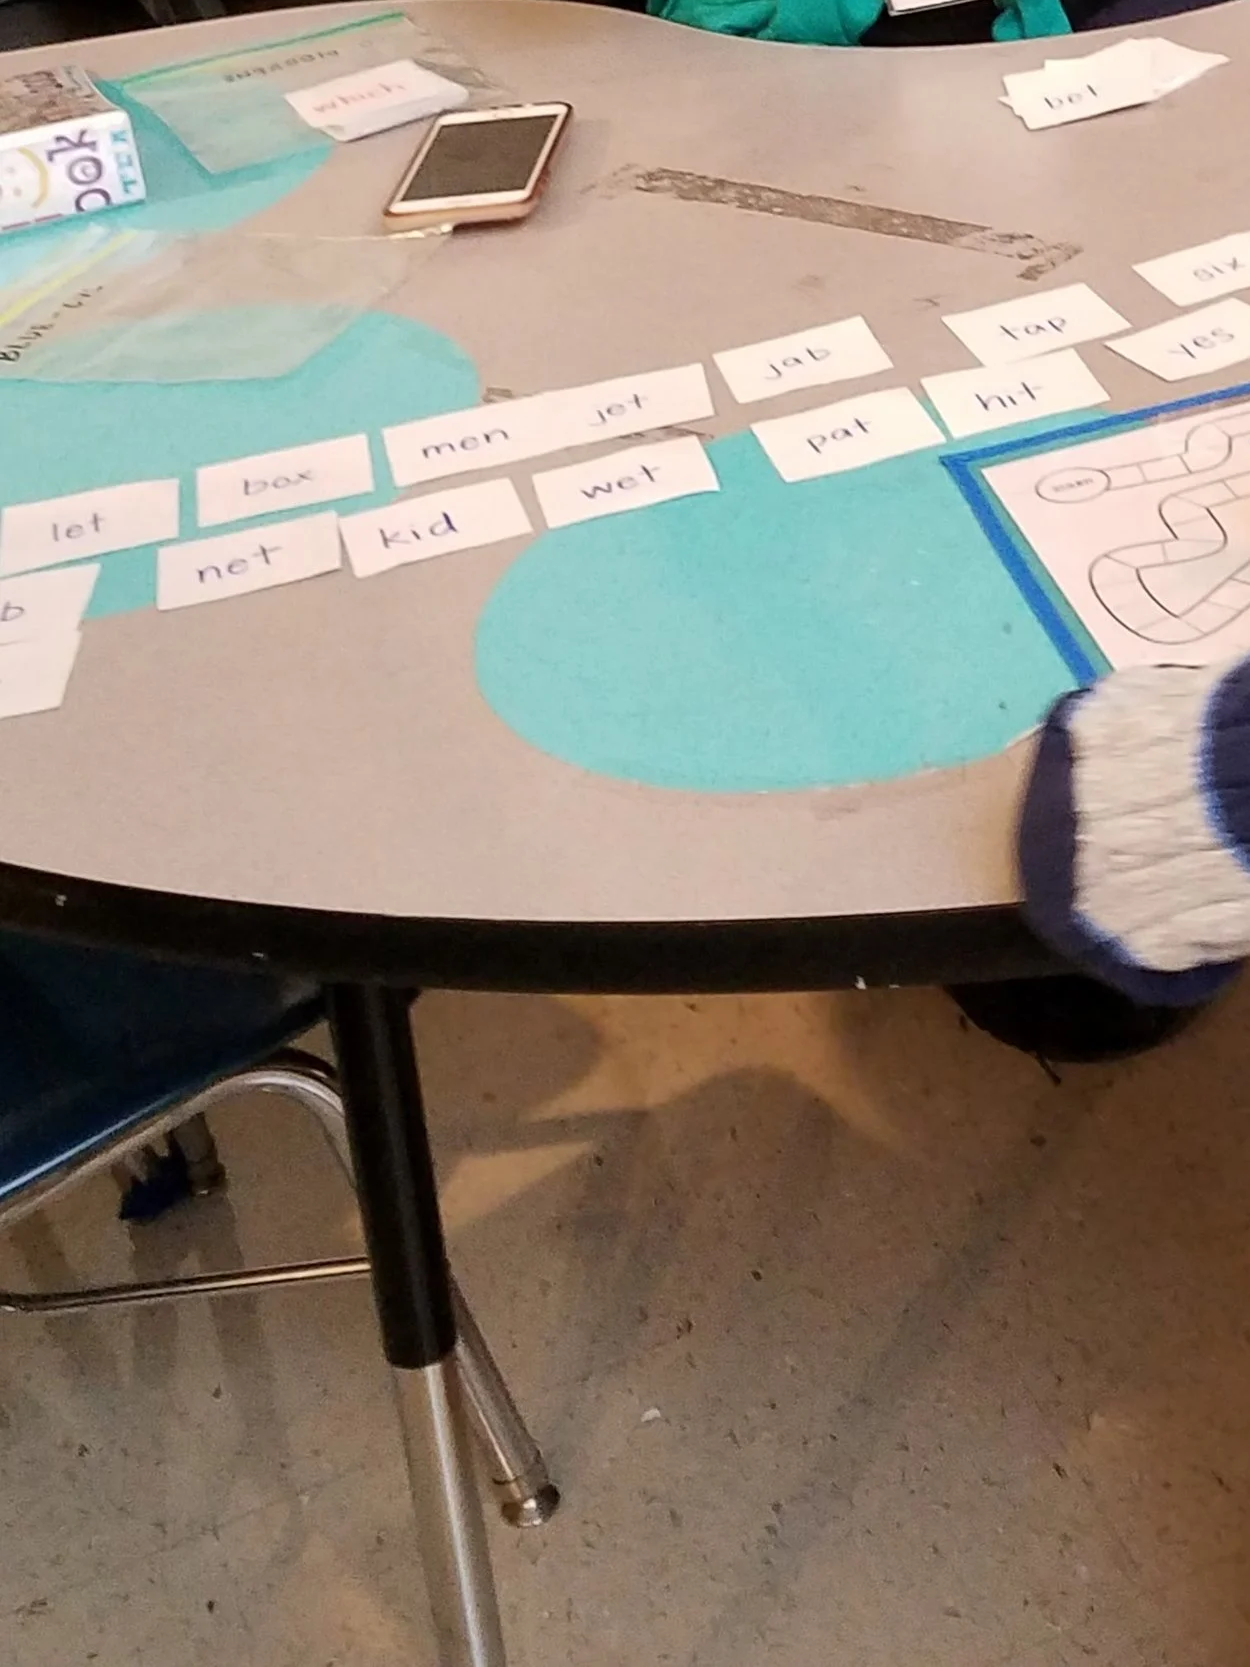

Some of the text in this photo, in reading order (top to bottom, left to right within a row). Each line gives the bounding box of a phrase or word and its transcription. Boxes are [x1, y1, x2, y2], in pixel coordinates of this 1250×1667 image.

[1000, 316, 1067, 341] tap
[1167, 327, 1235, 360] yes
[764, 347, 831, 380] jab
[974, 381, 1044, 412] hit
[807, 417, 873, 455] pat
[377, 511, 460, 549] kid
